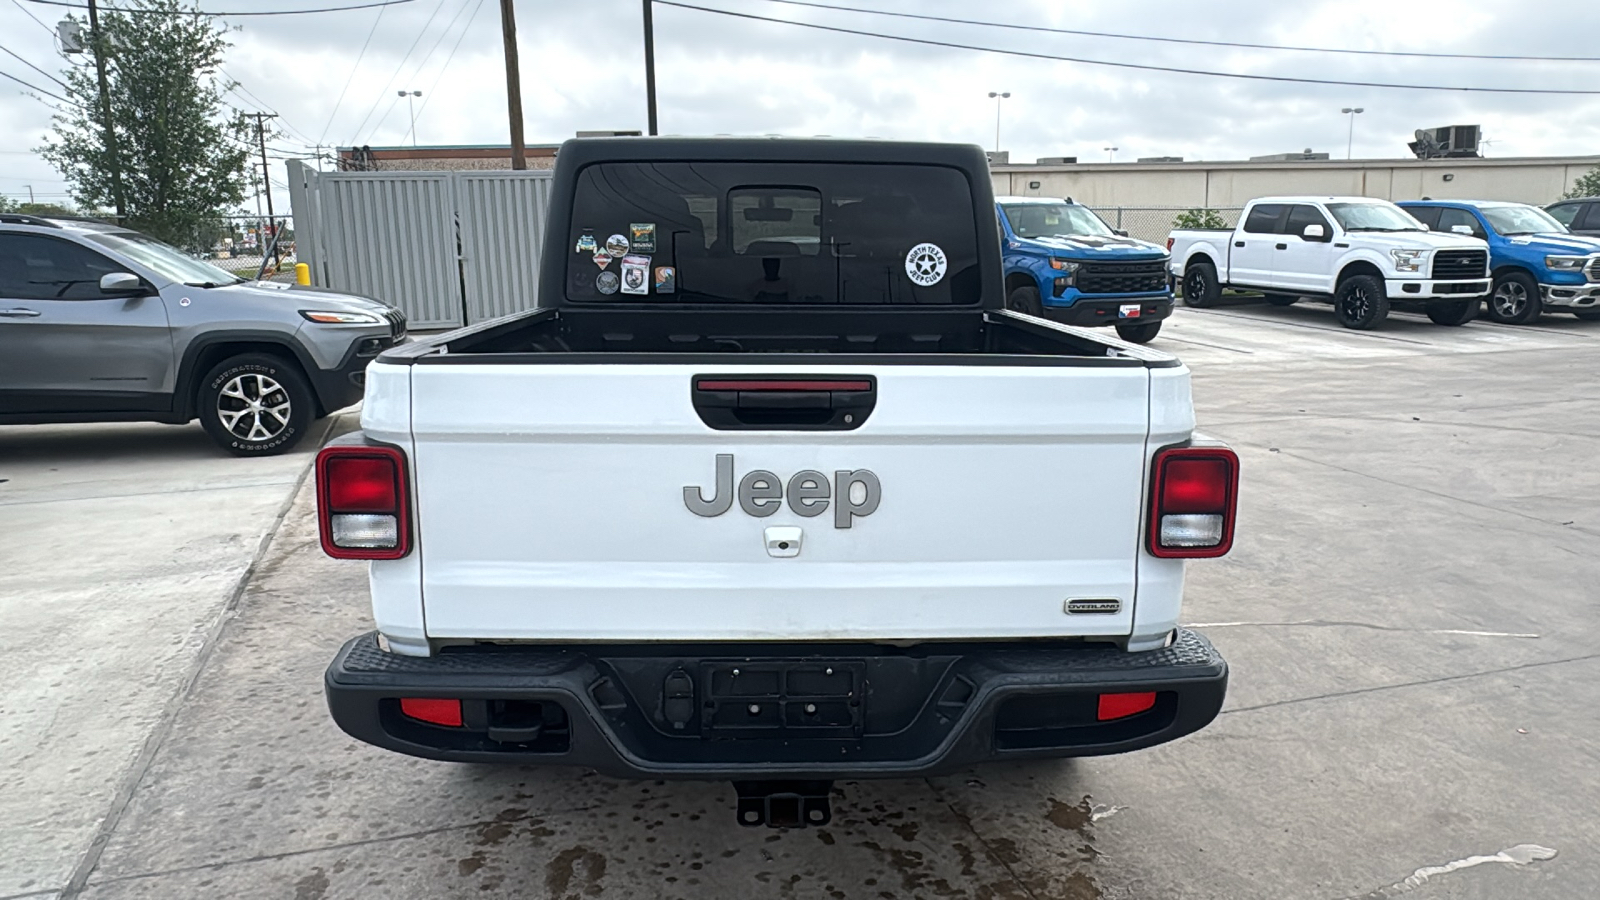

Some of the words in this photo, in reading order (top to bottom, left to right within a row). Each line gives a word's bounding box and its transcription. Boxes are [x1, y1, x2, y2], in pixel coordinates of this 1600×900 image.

[908, 246, 927, 264] NORTH
[927, 246, 945, 265] TEXAS
[909, 269, 925, 282] JEEP
[924, 271, 941, 284] CLUB
[683, 453, 882, 529] Jeep
